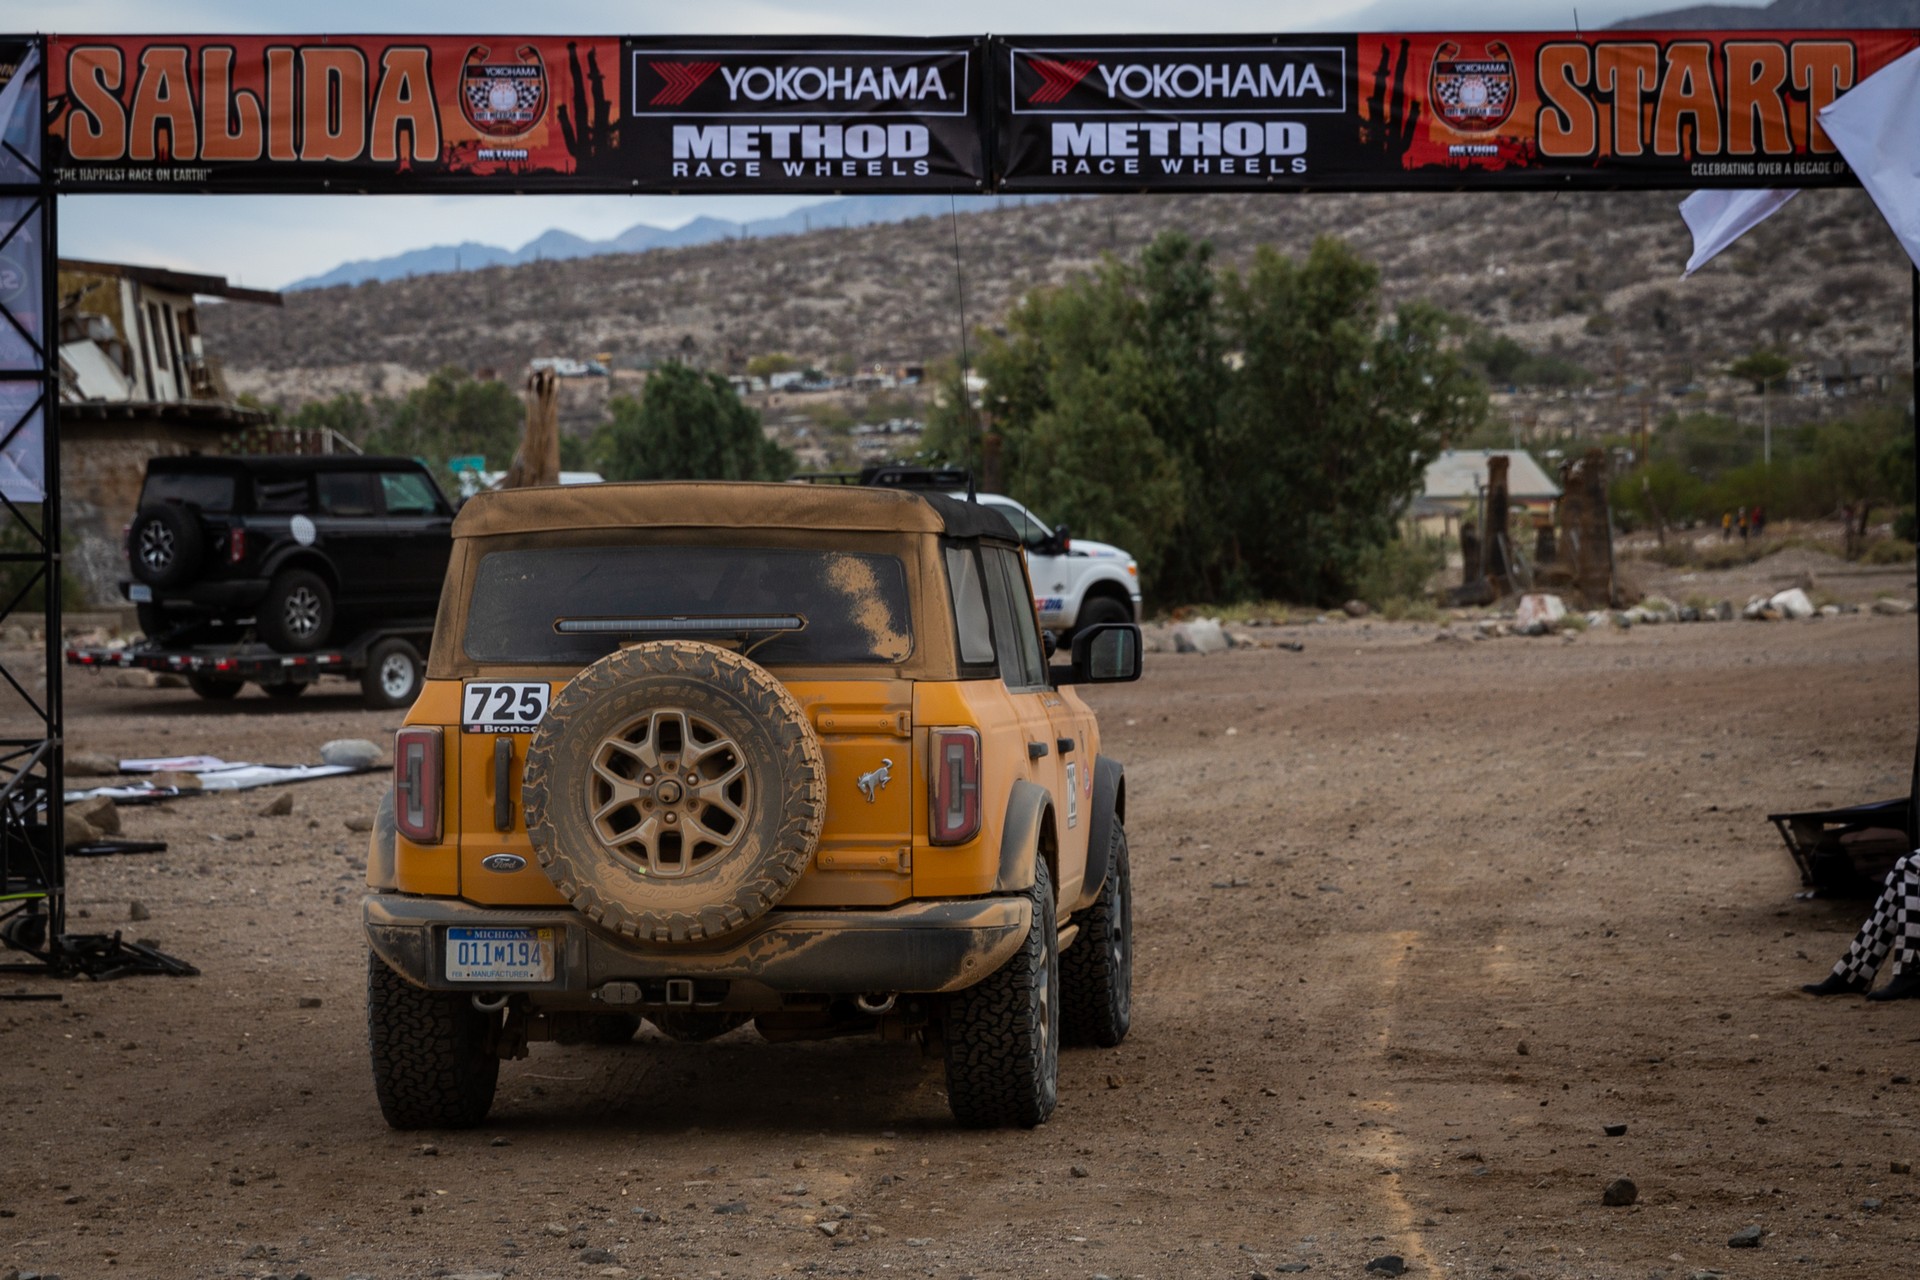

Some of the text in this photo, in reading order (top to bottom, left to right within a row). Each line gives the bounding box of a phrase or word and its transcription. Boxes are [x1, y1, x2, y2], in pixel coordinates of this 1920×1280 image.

[485, 67, 537, 77] YOKOHAMA
[1455, 63, 1506, 72] YOKOHAMA
[720, 66, 947, 101] YOKOHAMA
[1098, 63, 1325, 98] YOKOHAMA
[66, 45, 440, 161] SALIDA
[1538, 42, 1856, 156] START
[672, 124, 930, 160] METHOD
[1051, 122, 1307, 157] METHOD
[478, 150, 528, 158] METHOD
[1449, 145, 1498, 154] METHOD
[672, 160, 930, 177] RACE WHEELS
[1051, 157, 1307, 174] RACE WHEELS
[1691, 162, 1754, 176] CELEBRATING
[1757, 162, 1782, 175] OVER
[1784, 162, 1791, 175] A
[1793, 162, 1830, 174] DECADE
[1833, 162, 1845, 174] OF
[80, 168, 125, 181] HAPPIEST
[129, 168, 153, 181] RACE
[156, 168, 170, 181] ON
[471, 686, 542, 721] 725
[492, 858, 517, 869] Ford
[474, 931, 527, 939] MICHIGAN
[458, 942, 541, 967] 011M194
